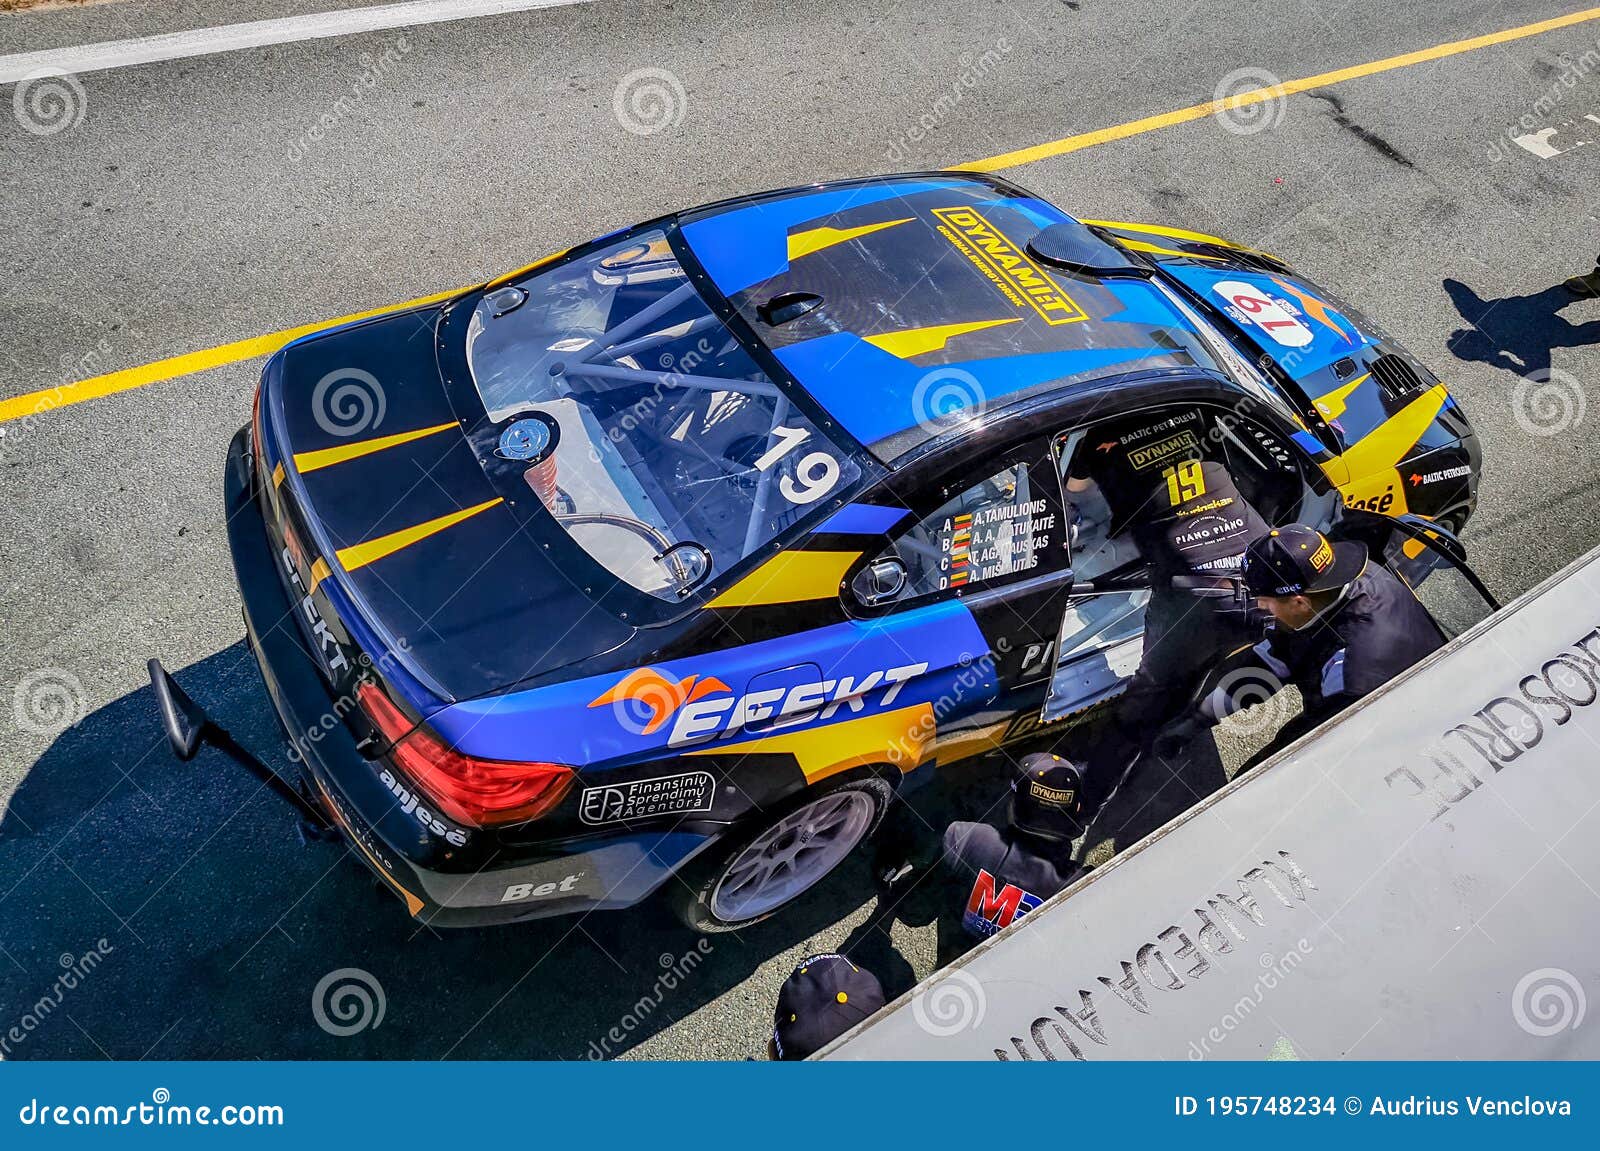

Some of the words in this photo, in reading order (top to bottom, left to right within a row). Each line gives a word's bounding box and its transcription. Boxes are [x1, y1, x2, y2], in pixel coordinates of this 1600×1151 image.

[968, 255, 1001, 282] ENERGY
[997, 282, 1026, 307] DRINK
[1119, 425, 1152, 446] BALTIC
[754, 426, 840, 504] 19
[1162, 459, 1206, 507] 19
[1423, 471, 1444, 484] BALTIC
[943, 519, 951, 532] A
[1176, 530, 1210, 544] PIANO
[1213, 518, 1244, 534] PIANO
[942, 538, 950, 552] B
[941, 558, 948, 570] C
[940, 577, 947, 590] D
[668, 662, 928, 748] EFEKT
[629, 774, 708, 795] Finansinių
[627, 786, 705, 807] Sprendimų
